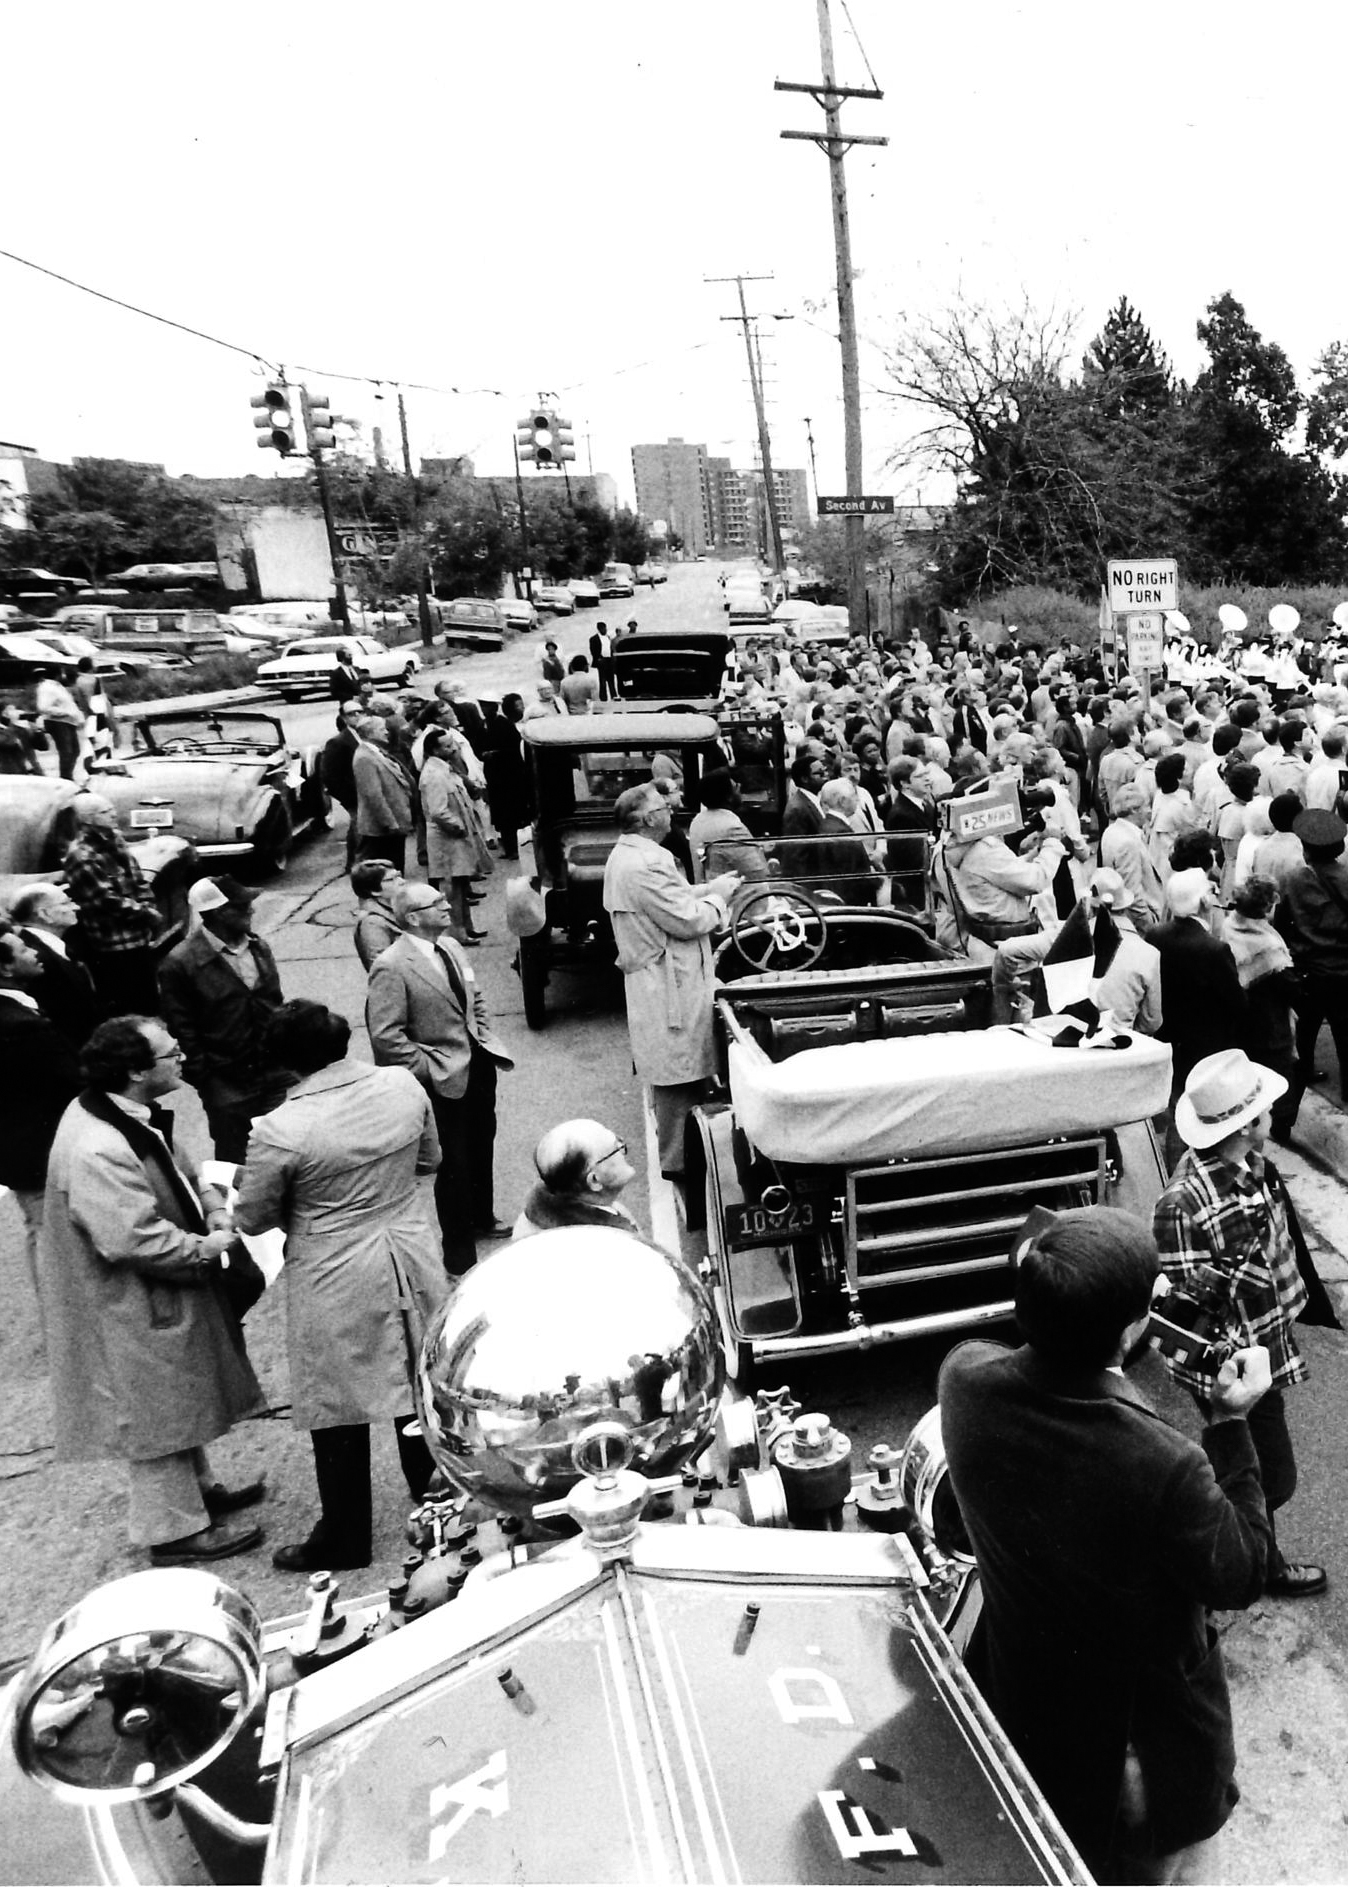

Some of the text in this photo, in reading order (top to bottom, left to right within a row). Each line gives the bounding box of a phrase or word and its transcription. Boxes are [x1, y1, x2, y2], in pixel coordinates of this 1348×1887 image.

[825, 500, 886, 511] Second Av
[1113, 570, 1174, 586] NO RIGHT
[1127, 590, 1162, 603] TURN
[1138, 620, 1151, 629] NO
